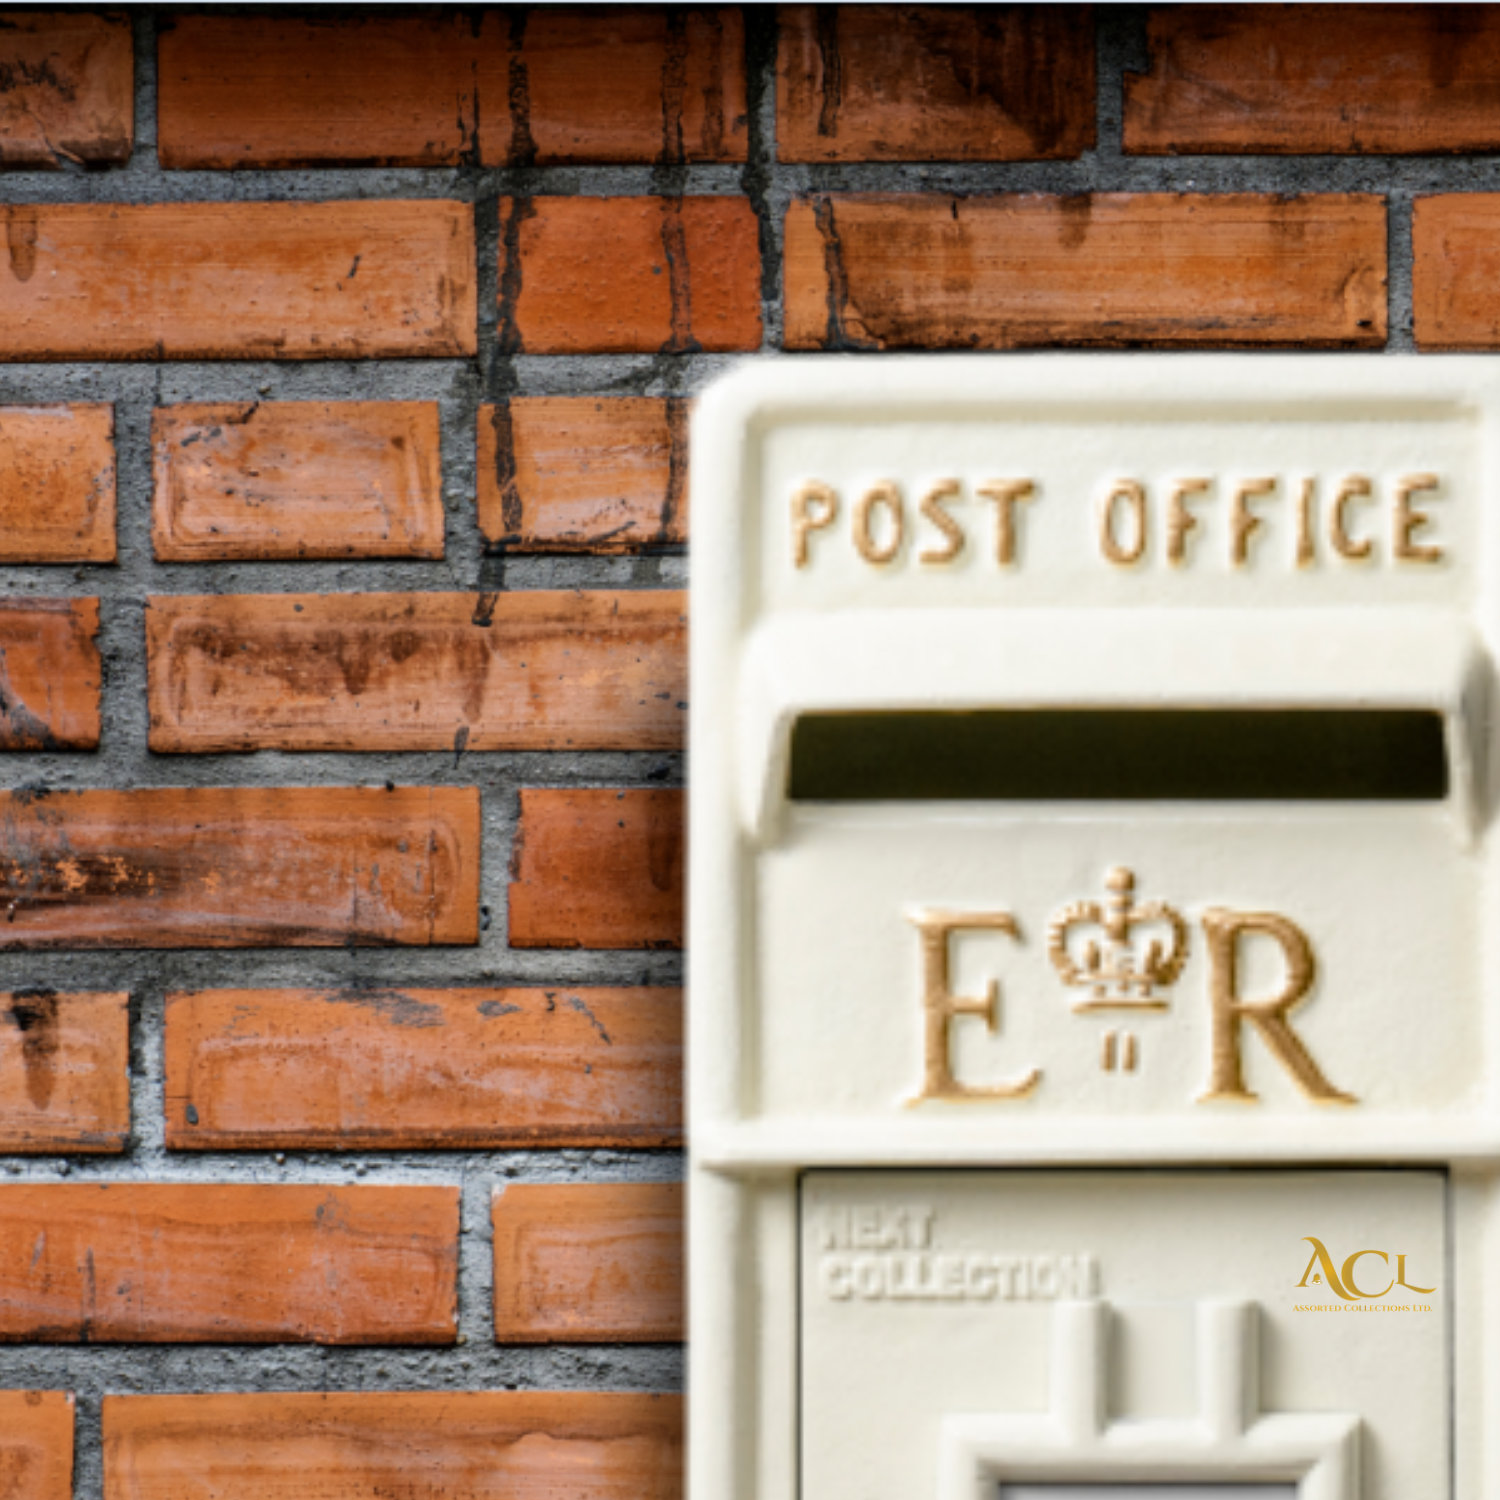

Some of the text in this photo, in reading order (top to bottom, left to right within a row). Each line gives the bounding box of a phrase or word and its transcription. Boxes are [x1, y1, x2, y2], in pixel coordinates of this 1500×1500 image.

[790, 473, 1444, 569] POST OFFICE
[906, 906, 1361, 1109] E R
[820, 1204, 938, 1250] NEXT
[819, 1252, 1105, 1301] COLLECTION
